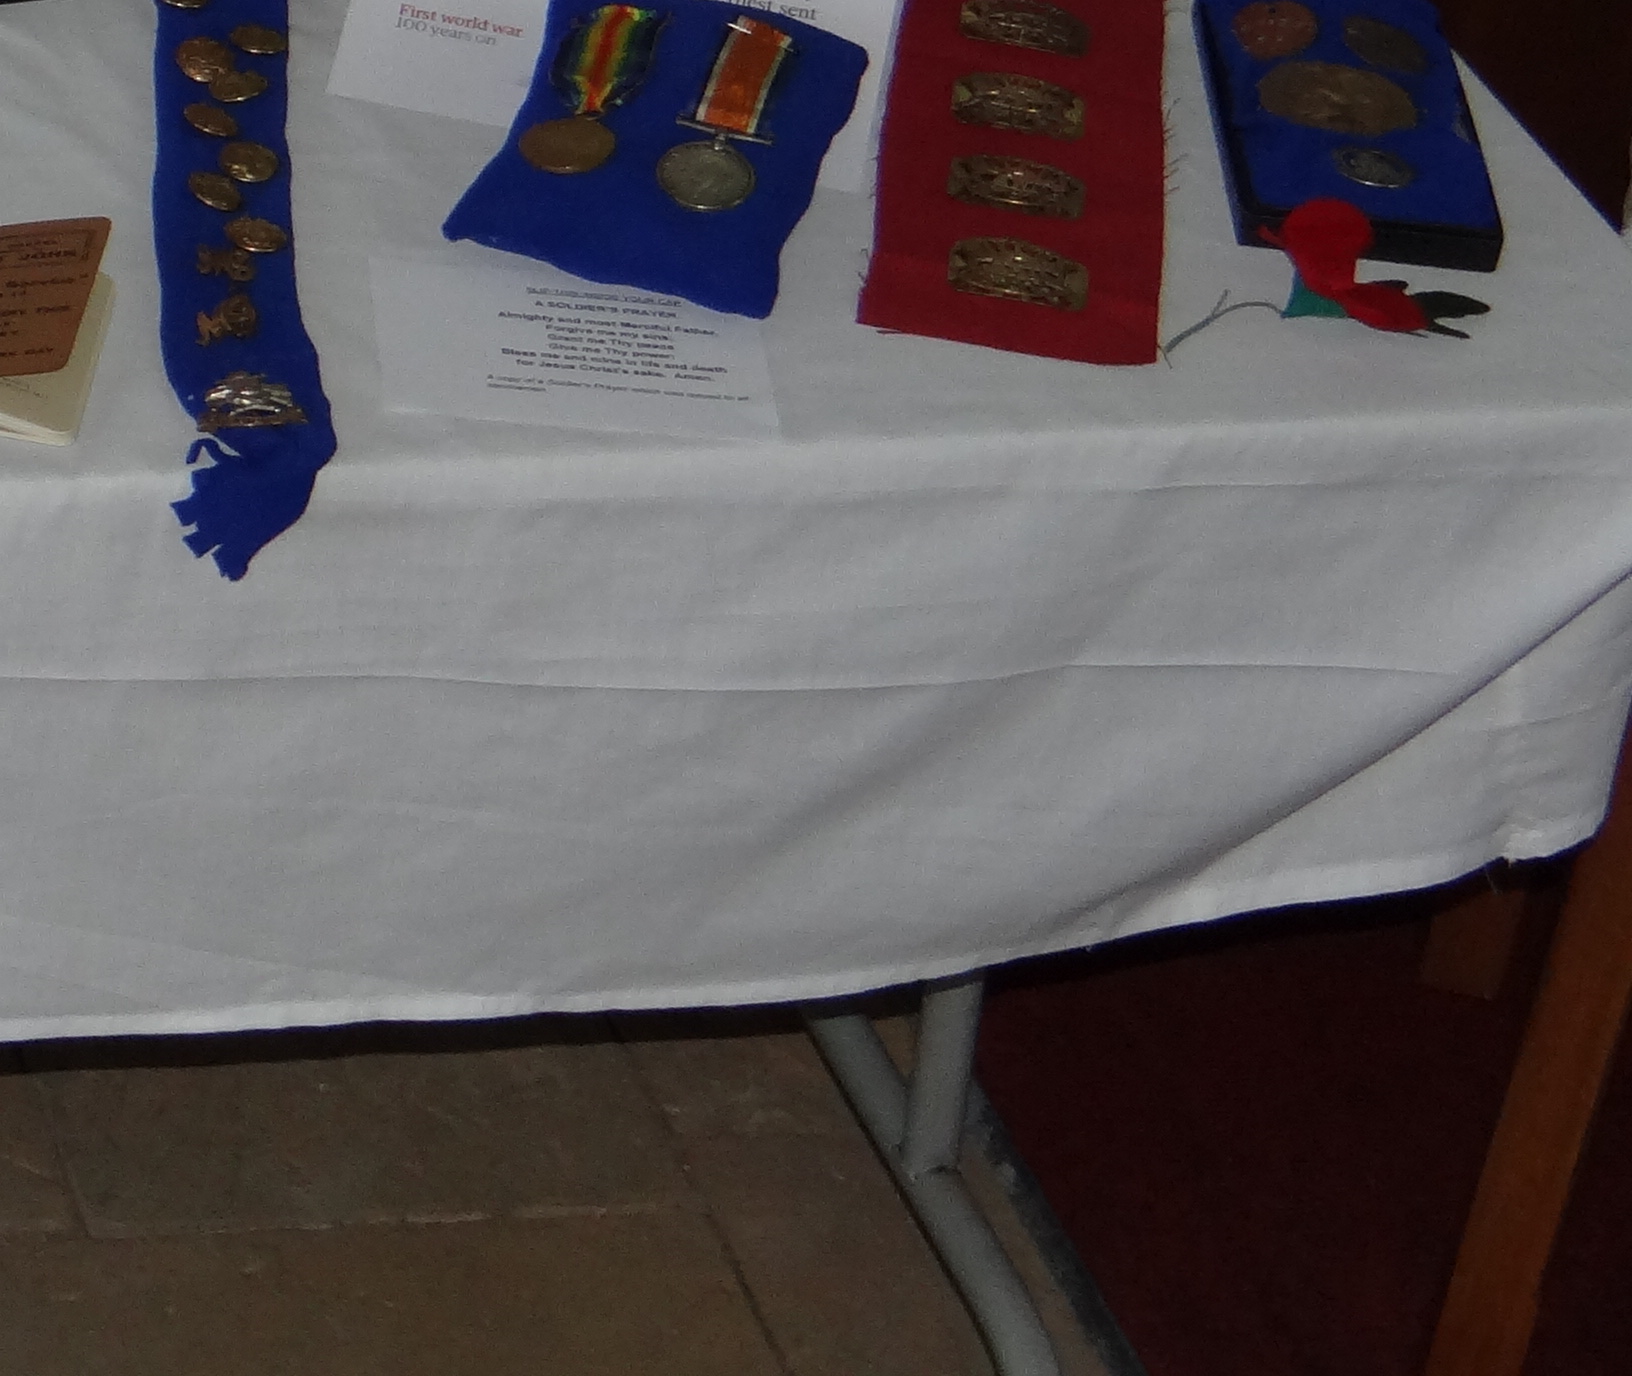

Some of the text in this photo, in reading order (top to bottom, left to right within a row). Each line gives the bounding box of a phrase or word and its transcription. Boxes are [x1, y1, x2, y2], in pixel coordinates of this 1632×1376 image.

[399, 2, 524, 37] First world war
[778, 4, 818, 21] sent
[395, 16, 497, 46] 100 years on
